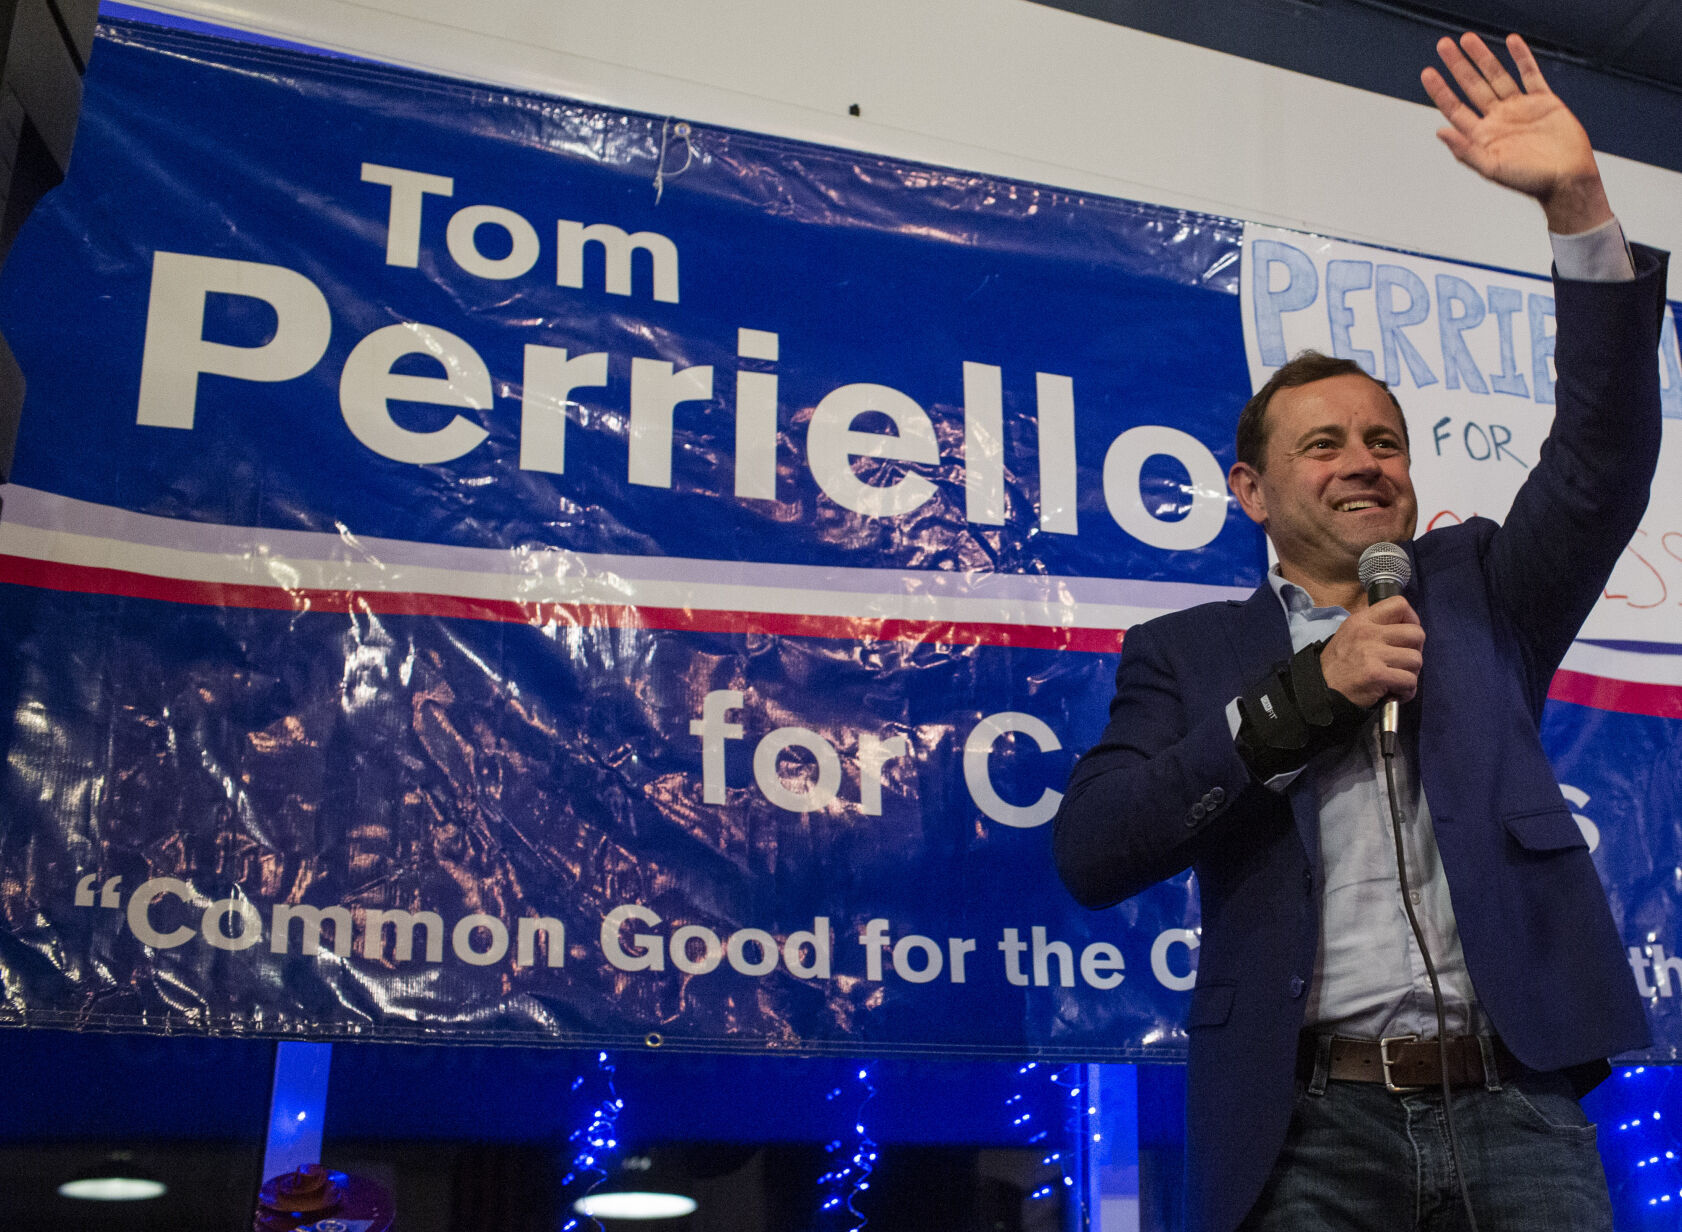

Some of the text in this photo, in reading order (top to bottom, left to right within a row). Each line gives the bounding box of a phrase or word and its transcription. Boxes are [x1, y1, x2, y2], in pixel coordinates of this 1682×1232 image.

[361, 162, 680, 304] Tom
[136, 250, 1228, 551] Perriello
[1433, 416, 1528, 469] FOR
[690, 689, 905, 817] for
[600, 903, 832, 980] Good
[858, 919, 976, 983] for
[998, 925, 1126, 990] the
